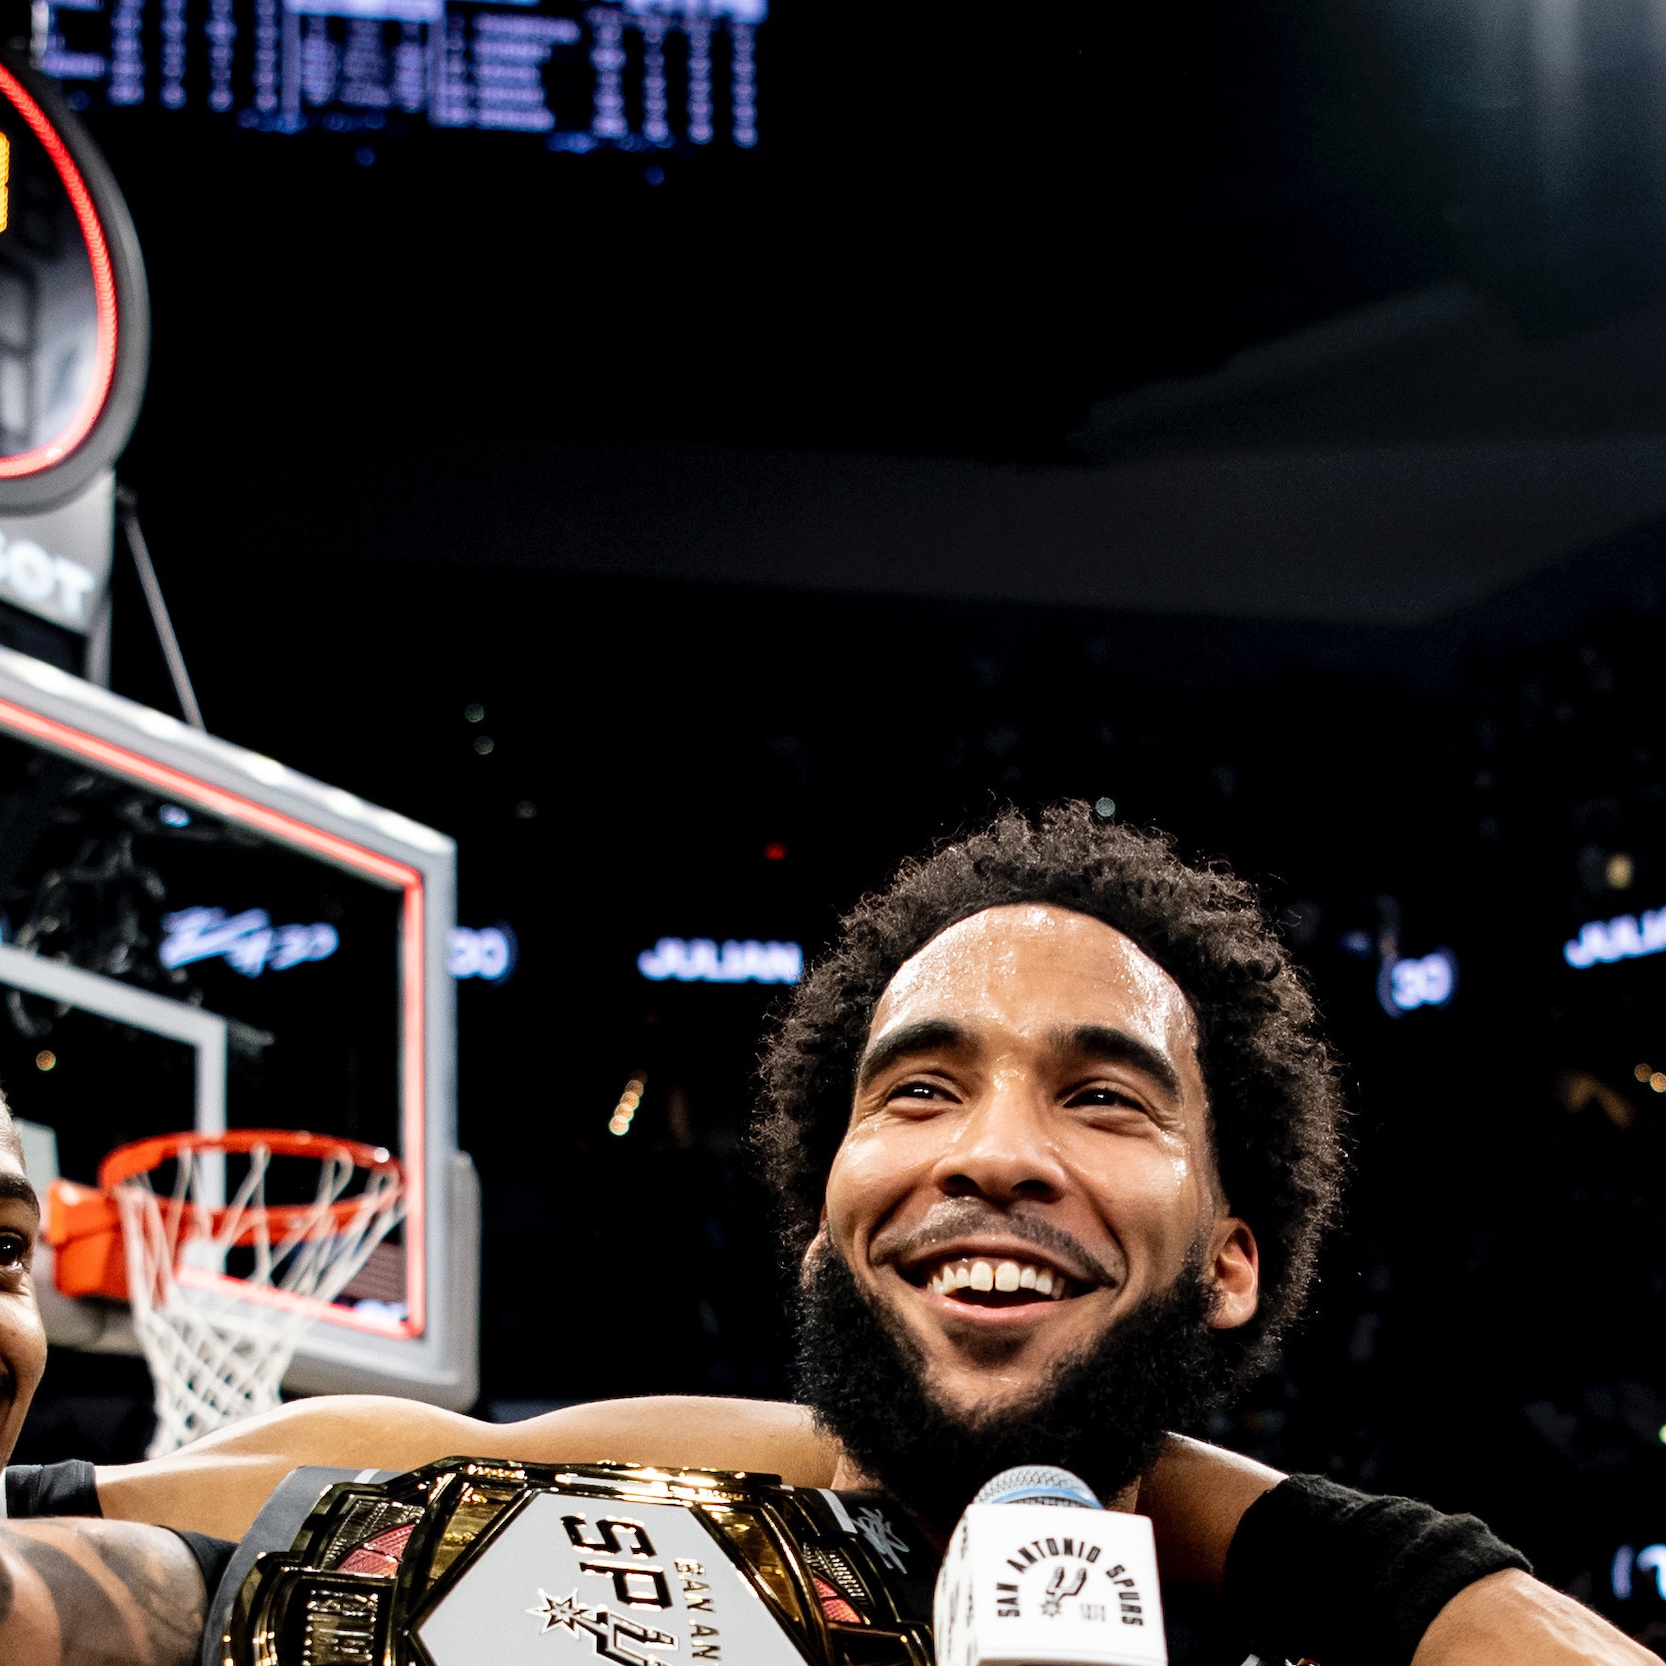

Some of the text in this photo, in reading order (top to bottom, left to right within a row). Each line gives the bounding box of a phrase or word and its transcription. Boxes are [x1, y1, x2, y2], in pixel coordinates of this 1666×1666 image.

[637, 936, 804, 985] JULIAN
[1391, 951, 1454, 1011] 30
[1006, 1537, 1102, 1574] ANTONIO
[673, 1558, 717, 1613] SAN
[996, 1582, 1021, 1618] SAN
[1105, 1564, 1144, 1627] SPURS
